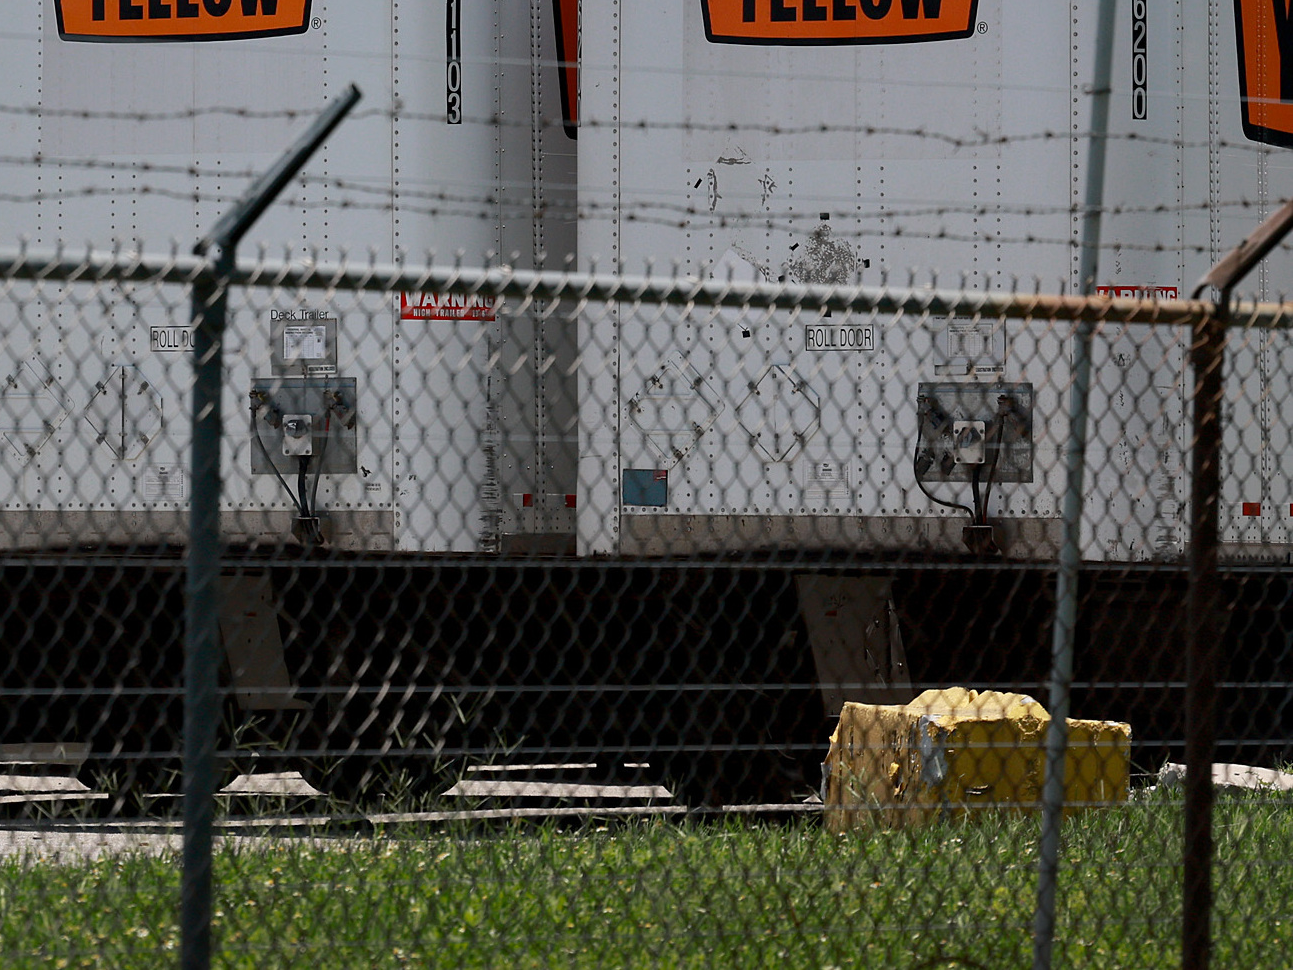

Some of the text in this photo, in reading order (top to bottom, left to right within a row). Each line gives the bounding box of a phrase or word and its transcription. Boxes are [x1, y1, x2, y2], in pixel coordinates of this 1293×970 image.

[271, 309, 329, 320] Deck Trailer
[152, 330, 179, 347] ROLL
[808, 328, 872, 346] ROLL DOOR
